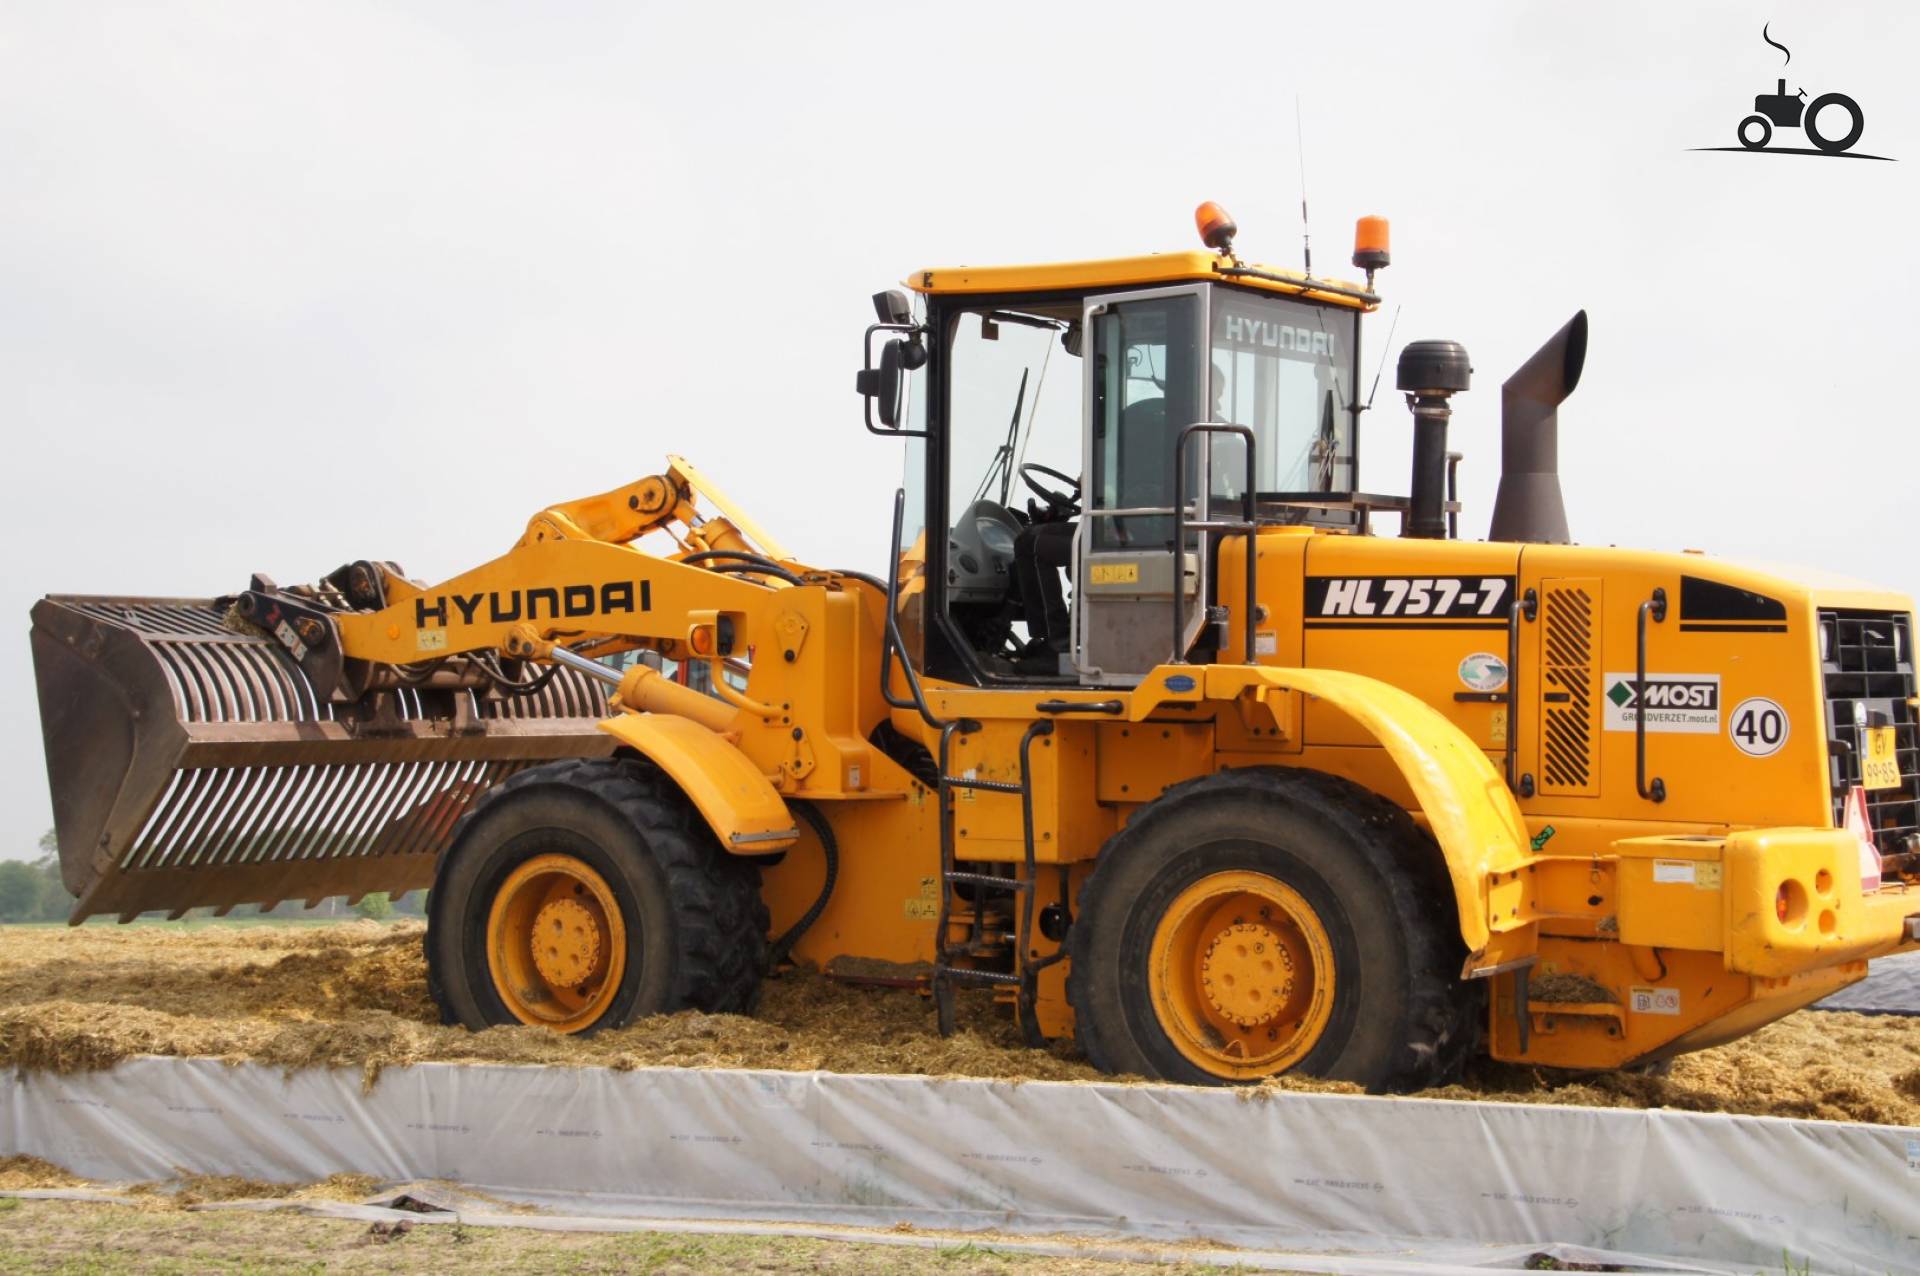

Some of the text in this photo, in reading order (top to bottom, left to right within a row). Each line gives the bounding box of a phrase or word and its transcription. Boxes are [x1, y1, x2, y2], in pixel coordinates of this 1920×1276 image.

[1226, 315, 1334, 357] HYUNDAI
[415, 579, 652, 629] HYUNDAI
[1633, 684, 1714, 707] MOST
[1622, 712, 1717, 723] GRDVERZET.most.nl
[1736, 709, 1782, 745] 40
